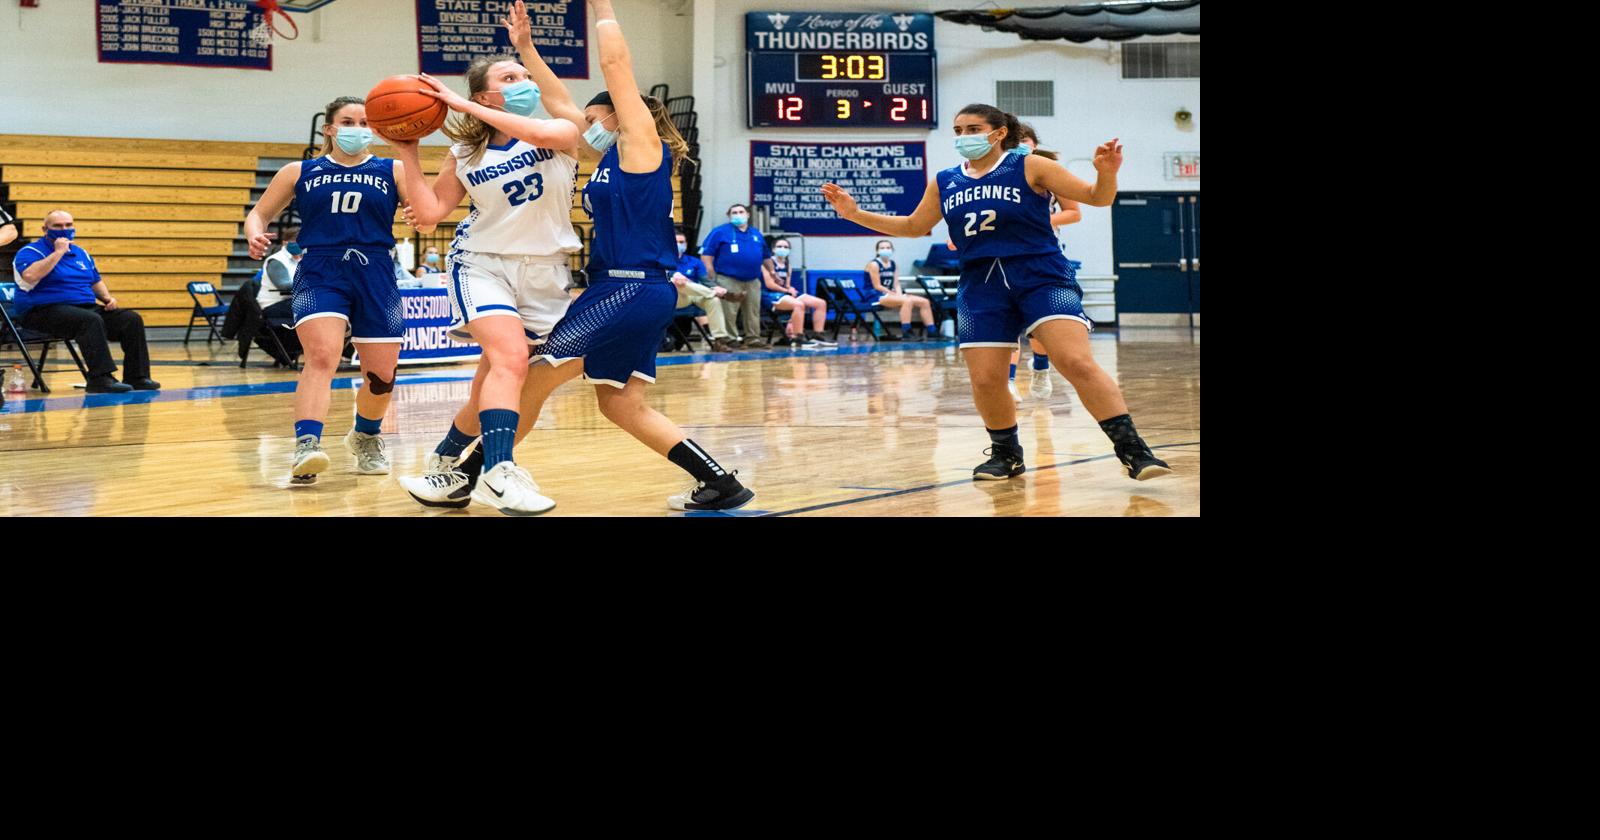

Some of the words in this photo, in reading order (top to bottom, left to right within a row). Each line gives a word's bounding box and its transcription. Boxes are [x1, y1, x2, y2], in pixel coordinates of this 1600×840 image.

[435, 0, 481, 10] STATE
[486, 1, 568, 13] CHAPIONS
[439, 12, 479, 22] DIVISION
[536, 15, 564, 26] FIELD
[798, 15, 843, 30] Home
[859, 15, 884, 30] the
[755, 32, 928, 50] THUNDERBIRDS
[821, 55, 884, 80] 3:03
[765, 83, 796, 95] MVU
[883, 83, 926, 95] GUEST
[826, 89, 860, 98] PERIOD
[778, 98, 803, 121] 12
[837, 100, 850, 119] 3
[890, 98, 928, 121] 21
[770, 145, 818, 157] STATE
[821, 145, 905, 157] CHAMPIONS
[753, 156, 794, 168] DIVISION
[807, 158, 843, 168] INDOOR
[846, 157, 879, 168] TRACK
[893, 156, 923, 168] FIELD
[305, 173, 389, 196] VERGENNES
[502, 172, 544, 207] 23
[331, 191, 363, 213] 10
[944, 185, 1021, 215] VERGENNES
[963, 209, 996, 237] 22
